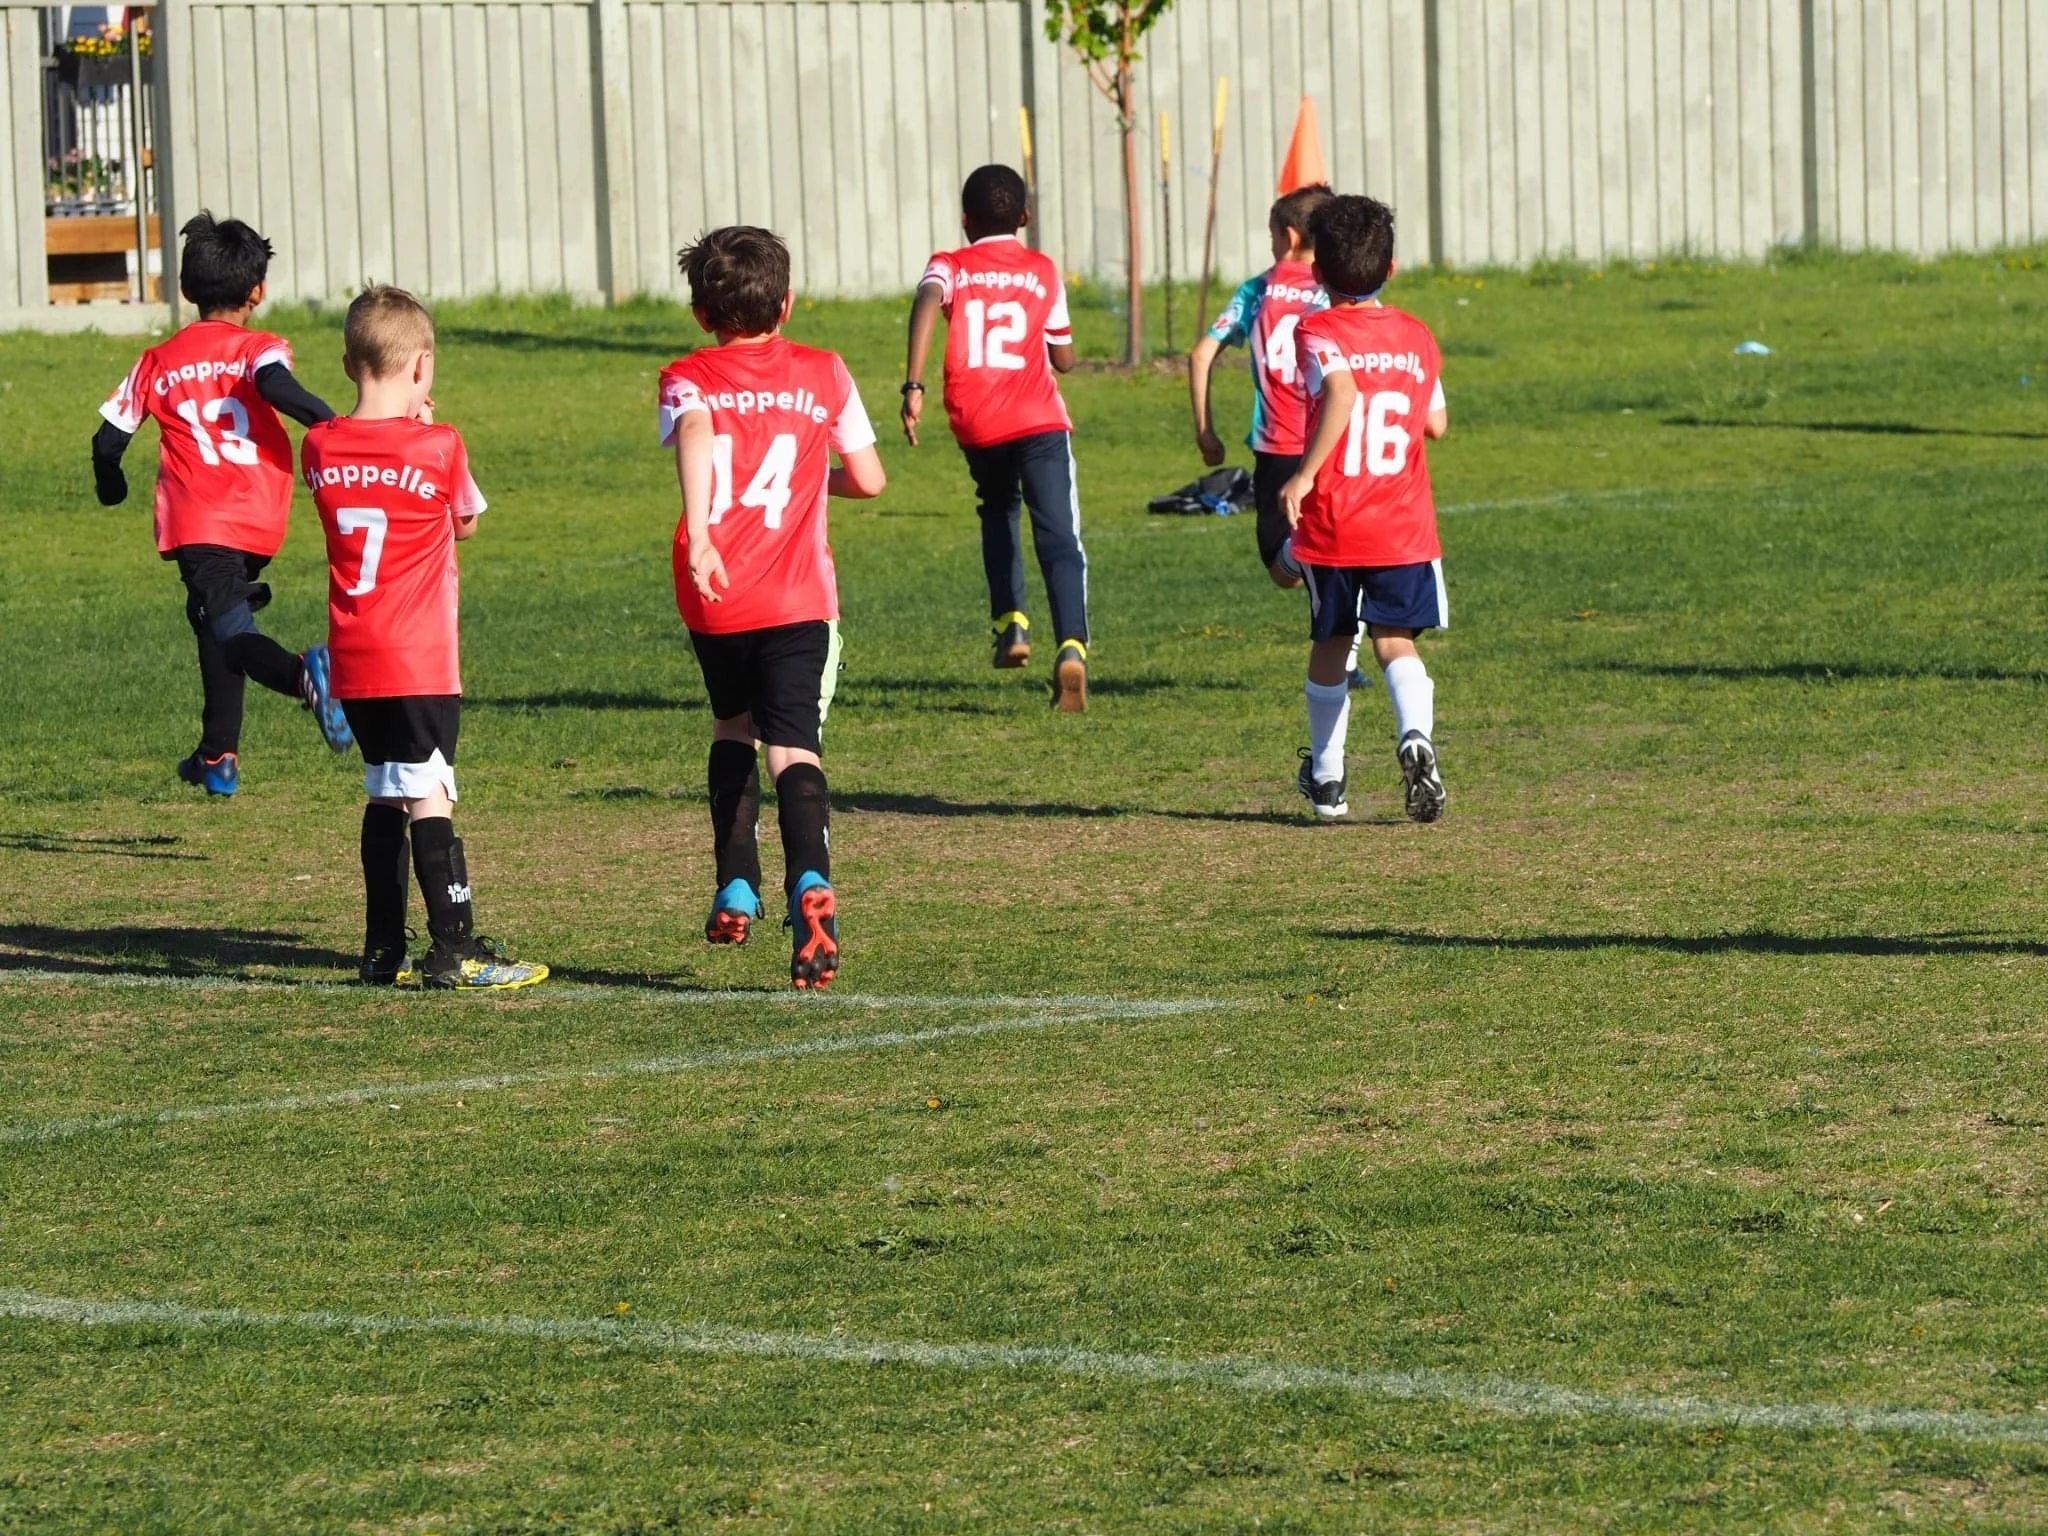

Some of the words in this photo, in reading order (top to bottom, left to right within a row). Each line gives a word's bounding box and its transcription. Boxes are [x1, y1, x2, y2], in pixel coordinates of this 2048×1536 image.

[964, 298, 1027, 370] 12
[1263, 313, 1300, 385] 4
[176, 396, 260, 466] 13
[1343, 390, 1411, 477] 16
[308, 464, 437, 500] happelle
[708, 433, 798, 530] 14
[336, 507, 389, 596] 7
